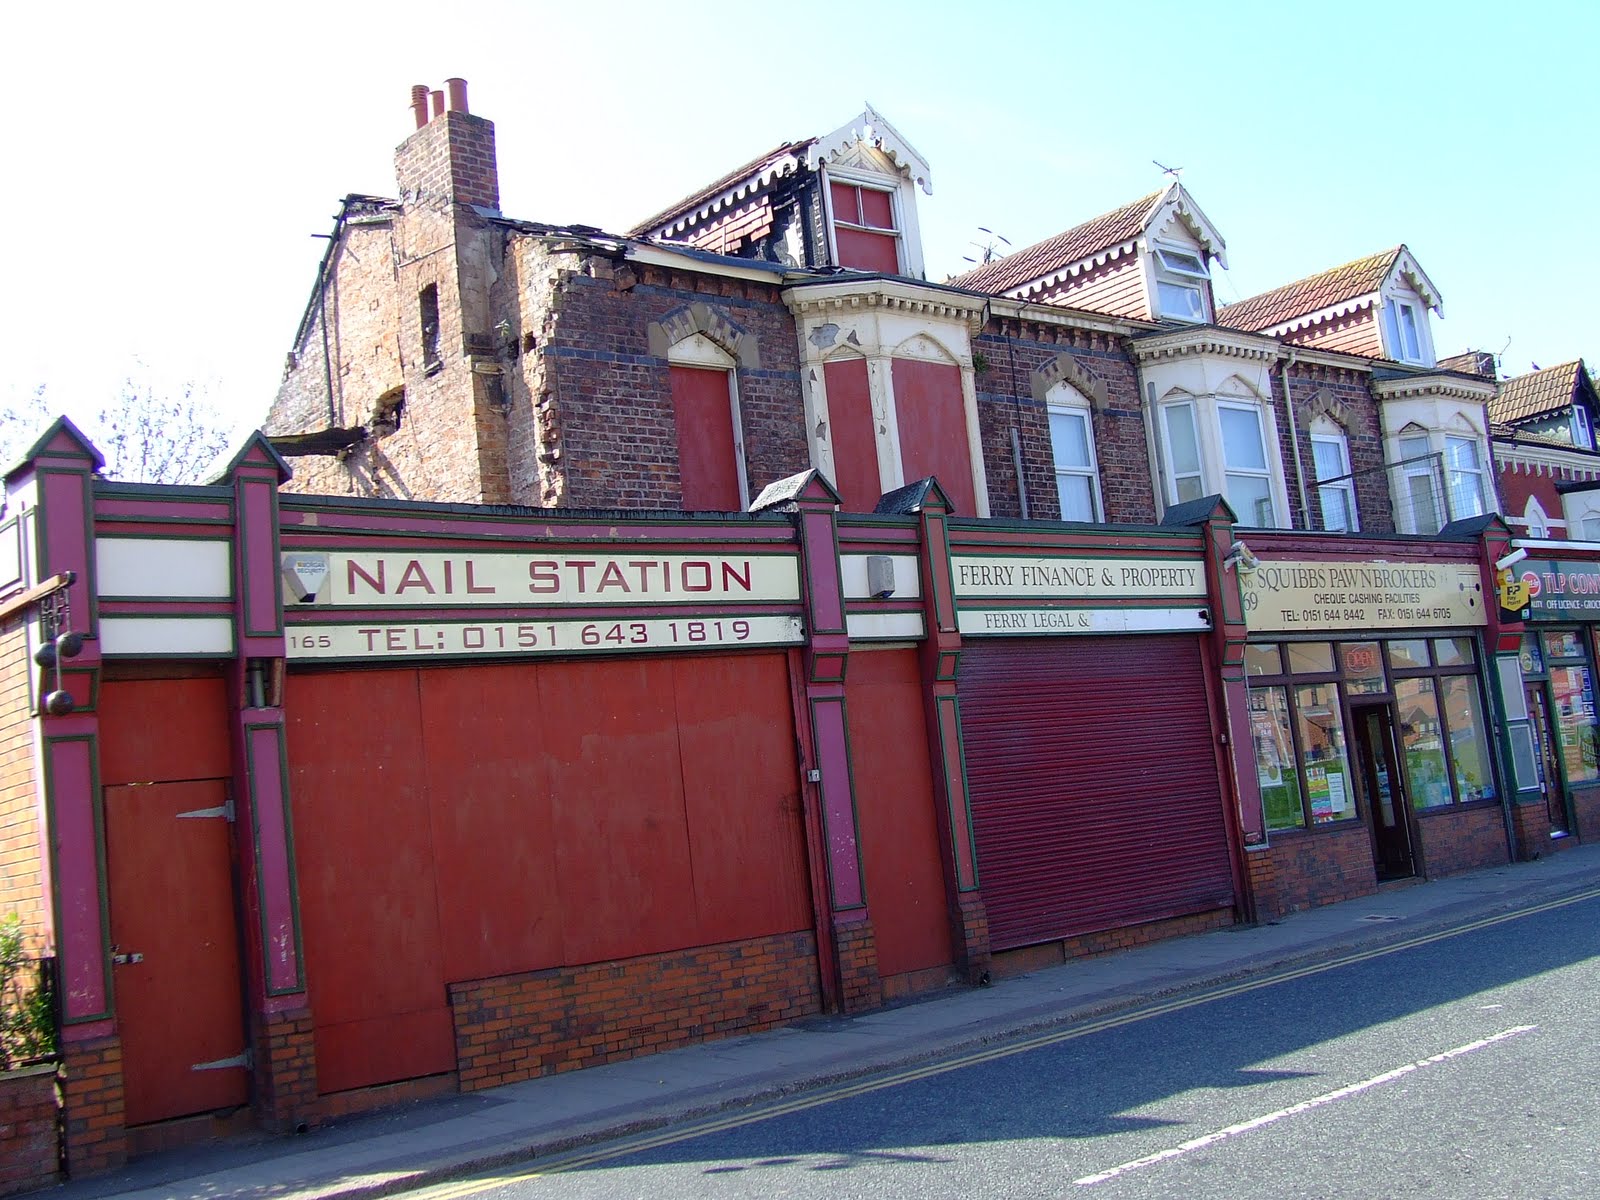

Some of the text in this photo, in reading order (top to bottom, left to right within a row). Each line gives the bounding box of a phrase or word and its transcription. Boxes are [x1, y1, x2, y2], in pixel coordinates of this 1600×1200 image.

[346, 560, 752, 594] NAIL STATION
[959, 565, 1196, 587] FERRY FINANCE & PROPERTY
[1257, 568, 1326, 592] SQUIBBS
[1330, 568, 1437, 589] PAWNBROKERS
[1542, 572, 1566, 594] TLP
[1569, 572, 1600, 595] CON
[1314, 593, 1420, 604] CHEQUE CASHING FACILITIES
[984, 613, 1090, 628] FERRY LEGAL &
[1281, 607, 1452, 622] TEL: 0151 644 8442 FAX: 0151 644 6705
[290, 635, 331, 648] 165
[359, 621, 751, 651] TEL: 0151 643 1819
[1347, 650, 1375, 666] OPEN
